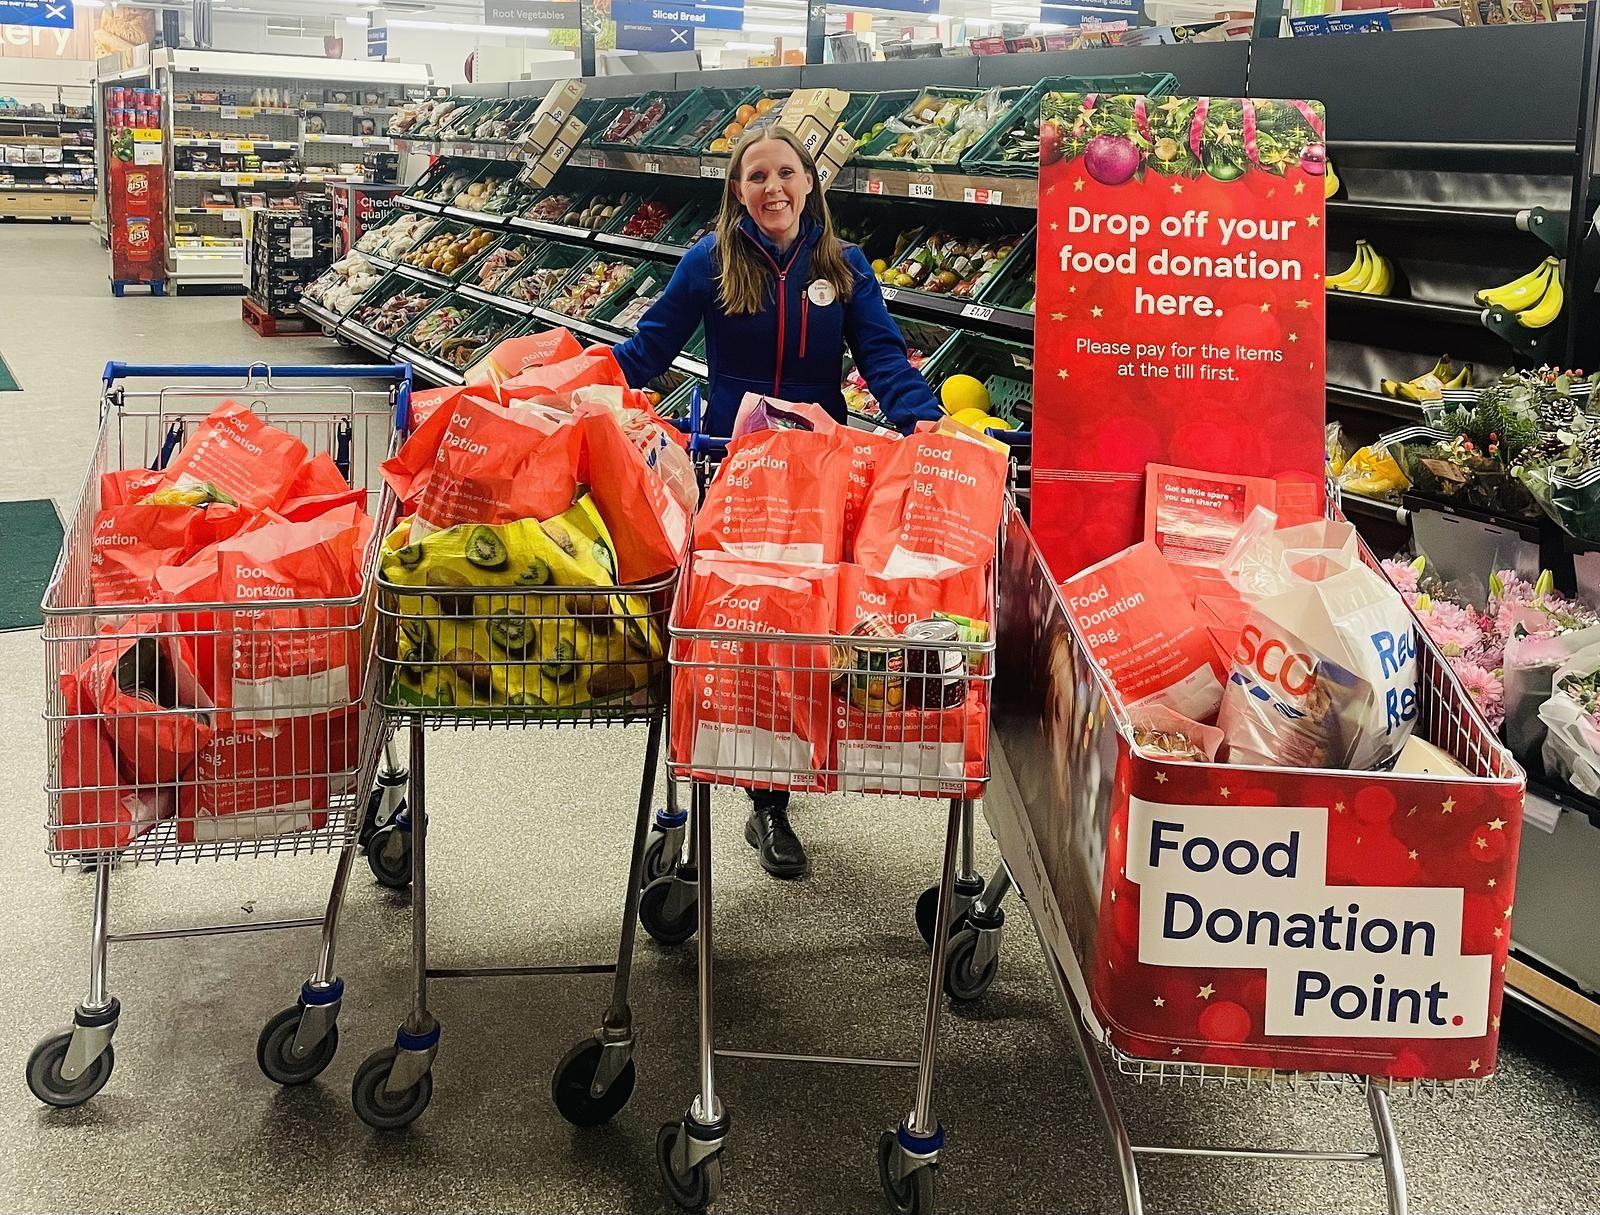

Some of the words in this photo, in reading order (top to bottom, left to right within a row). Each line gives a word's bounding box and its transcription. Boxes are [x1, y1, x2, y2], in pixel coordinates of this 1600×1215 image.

[493, 8, 515, 19] Root
[516, 9, 566, 22] Vegetables
[652, 9, 679, 21] Sliced
[680, 11, 706, 23] Bread
[1081, 15, 1103, 24] Indian
[1294, 24, 1320, 33] SKITCH
[1330, 24, 1354, 32] SKITCH
[0, 24, 71, 57] ery
[804, 133, 817, 151] 30p
[553, 145, 566, 159] 30p
[915, 184, 932, 197] £1.49
[1068, 206, 1150, 242] Drop
[1160, 210, 1209, 237] off
[1217, 218, 1296, 245] your
[1060, 245, 1137, 275] food
[1148, 249, 1302, 281] donation
[1135, 287, 1224, 317] here.
[969, 306, 991, 318] £1.70
[1076, 338, 1131, 355] Please
[1136, 343, 1166, 357] pay
[1170, 342, 1196, 358] for
[1200, 343, 1231, 359] the
[1235, 345, 1283, 362] items
[1117, 363, 1135, 377] at
[1140, 362, 1169, 378] the
[1174, 363, 1194, 379] till
[1200, 365, 1240, 381] first.
[411, 395, 443, 408] Food
[224, 410, 250, 433] Food
[451, 411, 472, 429] od
[214, 421, 264, 457] Donation
[443, 430, 488, 456] nation
[733, 443, 766, 459] Food
[853, 445, 872, 455] od
[916, 444, 952, 462] Food
[730, 455, 788, 472] Donation
[726, 475, 752, 490] Bag.
[913, 461, 977, 487] Donation
[125, 477, 157, 493] Food
[1164, 483, 1180, 493] Got
[1187, 487, 1206, 497] little
[1206, 490, 1229, 501] spare
[1164, 493, 1179, 502] you
[1180, 496, 1195, 504] can
[1196, 498, 1222, 508] share?
[100, 516, 115, 529] od
[92, 533, 139, 547] onation
[236, 584, 295, 598] Donation
[1069, 585, 1109, 611] Food
[719, 594, 760, 612] Food
[1078, 591, 1145, 630] Donation
[713, 612, 786, 634] Donation
[855, 605, 918, 626] Dotion
[1087, 627, 1121, 649] Bag.
[1233, 624, 1318, 696] SCO
[701, 723, 713, 731] This
[207, 732, 270, 748] onatio
[199, 750, 227, 767] ag.
[1149, 819, 1300, 879] Food
[1162, 892, 1436, 957] Donation
[1294, 969, 1464, 1027] Point.
